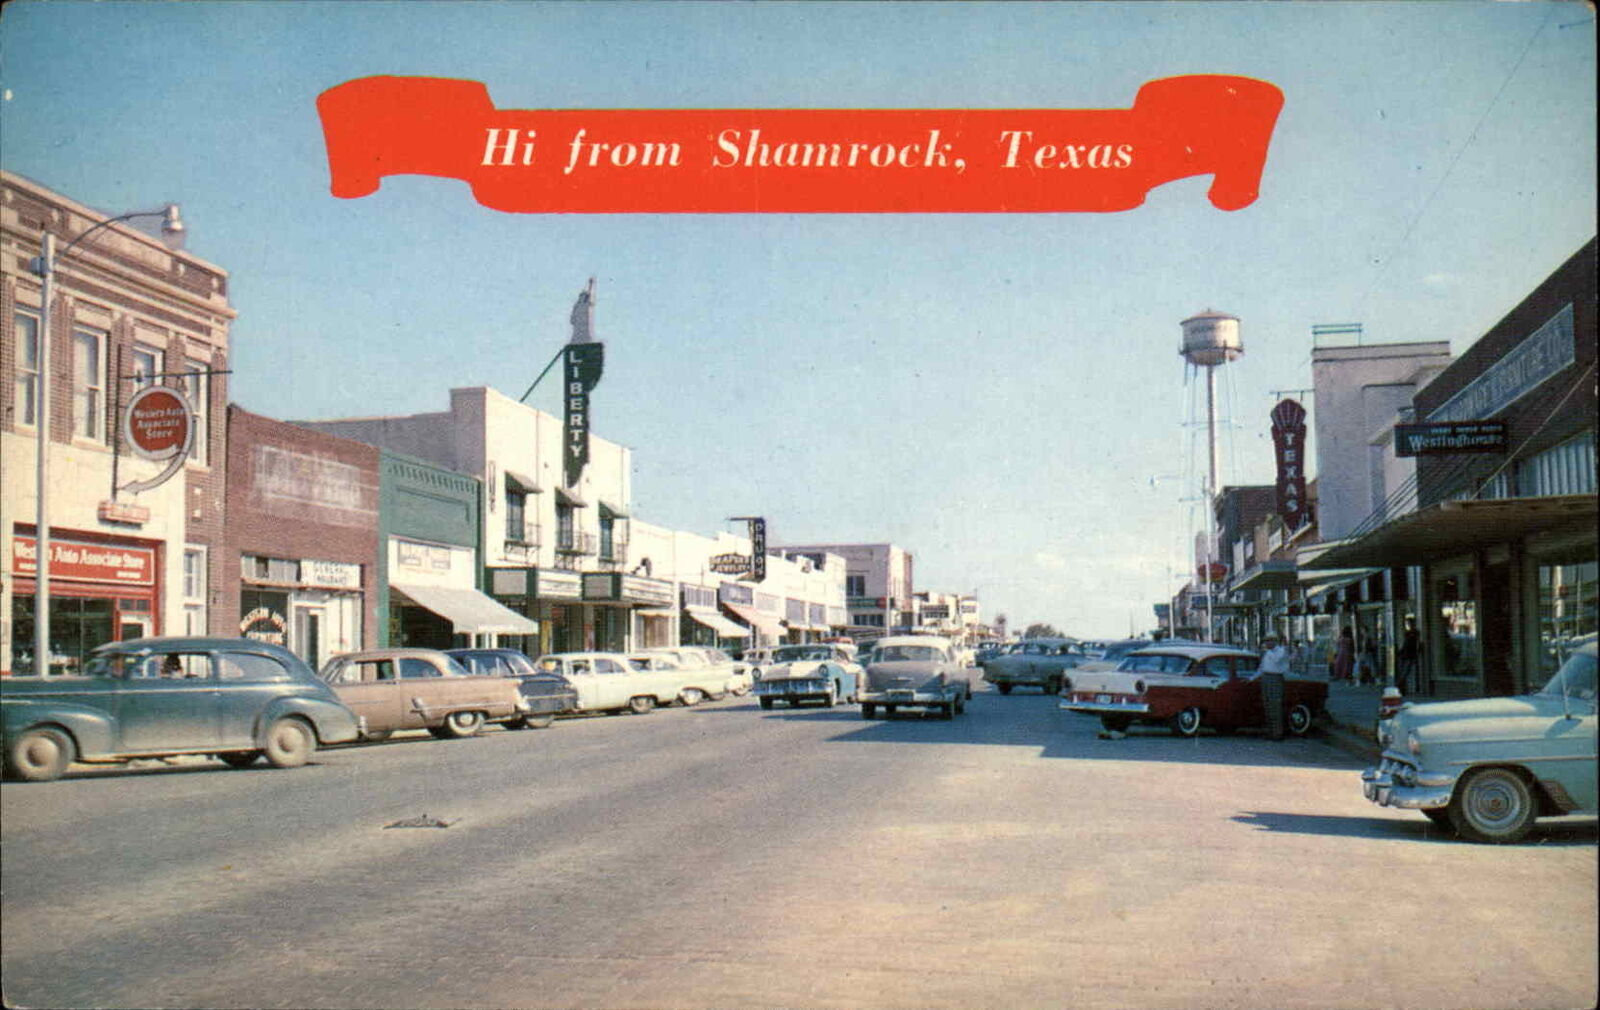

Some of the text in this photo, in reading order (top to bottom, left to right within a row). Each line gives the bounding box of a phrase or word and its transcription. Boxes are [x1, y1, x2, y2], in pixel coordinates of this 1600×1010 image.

[569, 350, 583, 457] LIBERTY
[136, 419, 180, 429] Associate
[146, 428, 174, 439] Store
[1284, 432, 1298, 512] TEXAS
[55, 546, 79, 563] Auto
[122, 552, 145, 569] Store
